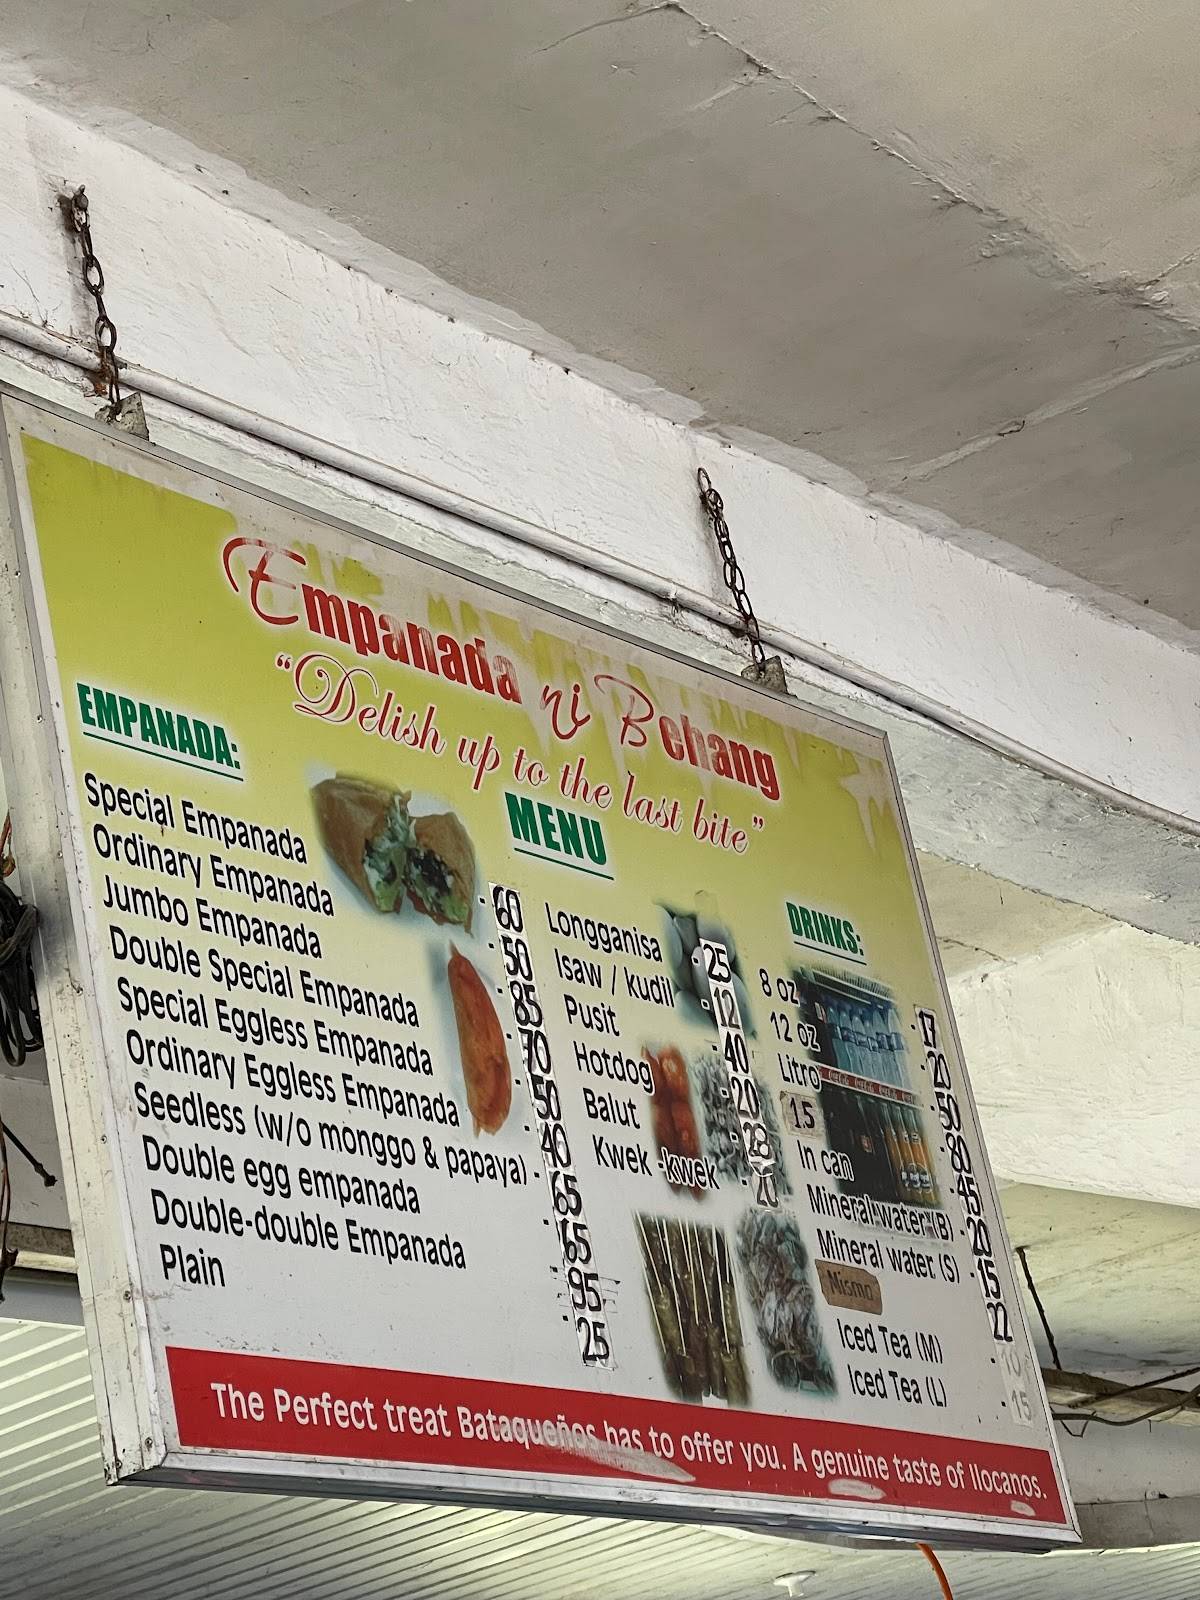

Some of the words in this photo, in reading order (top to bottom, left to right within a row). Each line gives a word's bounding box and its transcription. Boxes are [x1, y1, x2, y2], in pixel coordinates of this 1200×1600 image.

[222, 537, 522, 704] Empanada
[540, 683, 591, 740] ni
[594, 674, 781, 801] Behang
[76, 682, 241, 770] EMPANADA:
[458, 735, 500, 791] up
[513, 748, 549, 786] to
[560, 756, 612, 809] the
[623, 772, 684, 833] last
[84, 772, 175, 828] Special
[181, 800, 307, 865] Empanada
[504, 791, 607, 866] MENU
[93, 823, 201, 888] Ordinary
[209, 854, 334, 917] Empanada
[104, 875, 189, 926] Jumbo
[195, 897, 322, 959] Empanada
[545, 902, 663, 962] Longganisa
[786, 901, 865, 957] DRINKS:
[109, 924, 201, 978] Double
[207, 948, 294, 999] Special
[299, 969, 419, 1027] Empanada
[554, 948, 602, 989] Isaw
[624, 966, 675, 1008] kudil
[759, 968, 772, 997] 8
[777, 978, 799, 1004] oz
[117, 976, 208, 1028] Special
[214, 998, 308, 1049] Eggless
[314, 1019, 433, 1076] Empanada
[564, 993, 620, 1036] Pusit
[770, 1011, 792, 1042] 12
[797, 1022, 820, 1052] oz
[126, 1029, 235, 1090] Ordinary
[244, 1052, 336, 1103] Eggless
[342, 1073, 460, 1127] Empanada
[573, 1040, 654, 1094] Hotdog
[777, 1053, 820, 1090] Litro
[134, 1081, 246, 1135] Seedless
[254, 1104, 312, 1148] (w/o
[319, 1120, 416, 1168] monggo
[424, 1136, 440, 1170] &
[445, 1143, 527, 1188] papaya)
[583, 1087, 640, 1129] Balut
[142, 1134, 235, 1184] Double
[243, 1157, 291, 1199] egg
[298, 1167, 420, 1214] empanada
[592, 1134, 652, 1176] Kwek
[797, 1139, 817, 1172] In
[821, 1149, 854, 1181] can
[150, 1188, 339, 1250] Double-double
[345, 1218, 466, 1270] Empanada
[807, 1183, 874, 1226] Mineral
[875, 1201, 926, 1237] water
[932, 1210, 954, 1242] (B)
[159, 1243, 226, 1287] Plain
[816, 1228, 884, 1269] Mineral
[939, 1253, 960, 1284] (S)
[837, 1318, 878, 1354] Iced
[878, 1325, 912, 1360] Tea
[916, 1332, 943, 1364] (M)
[987, 1302, 1013, 1342] 22
[847, 1364, 888, 1399] Iced
[888, 1370, 922, 1405] Tea
[925, 1376, 948, 1408] (L)
[210, 1382, 264, 1422] The
[273, 1387, 378, 1432] Perfect
[383, 1397, 452, 1438] treat
[456, 1405, 597, 1451] Bataqueños
[603, 1419, 644, 1452] has
[648, 1426, 673, 1458] to
[680, 1431, 735, 1466] offer
[740, 1441, 786, 1472] you.
[792, 1443, 808, 1473] A
[810, 1448, 890, 1481] genuine
[892, 1454, 940, 1487] taste
[946, 1459, 966, 1490] of
[968, 1463, 1047, 1500] Ilocanos.
